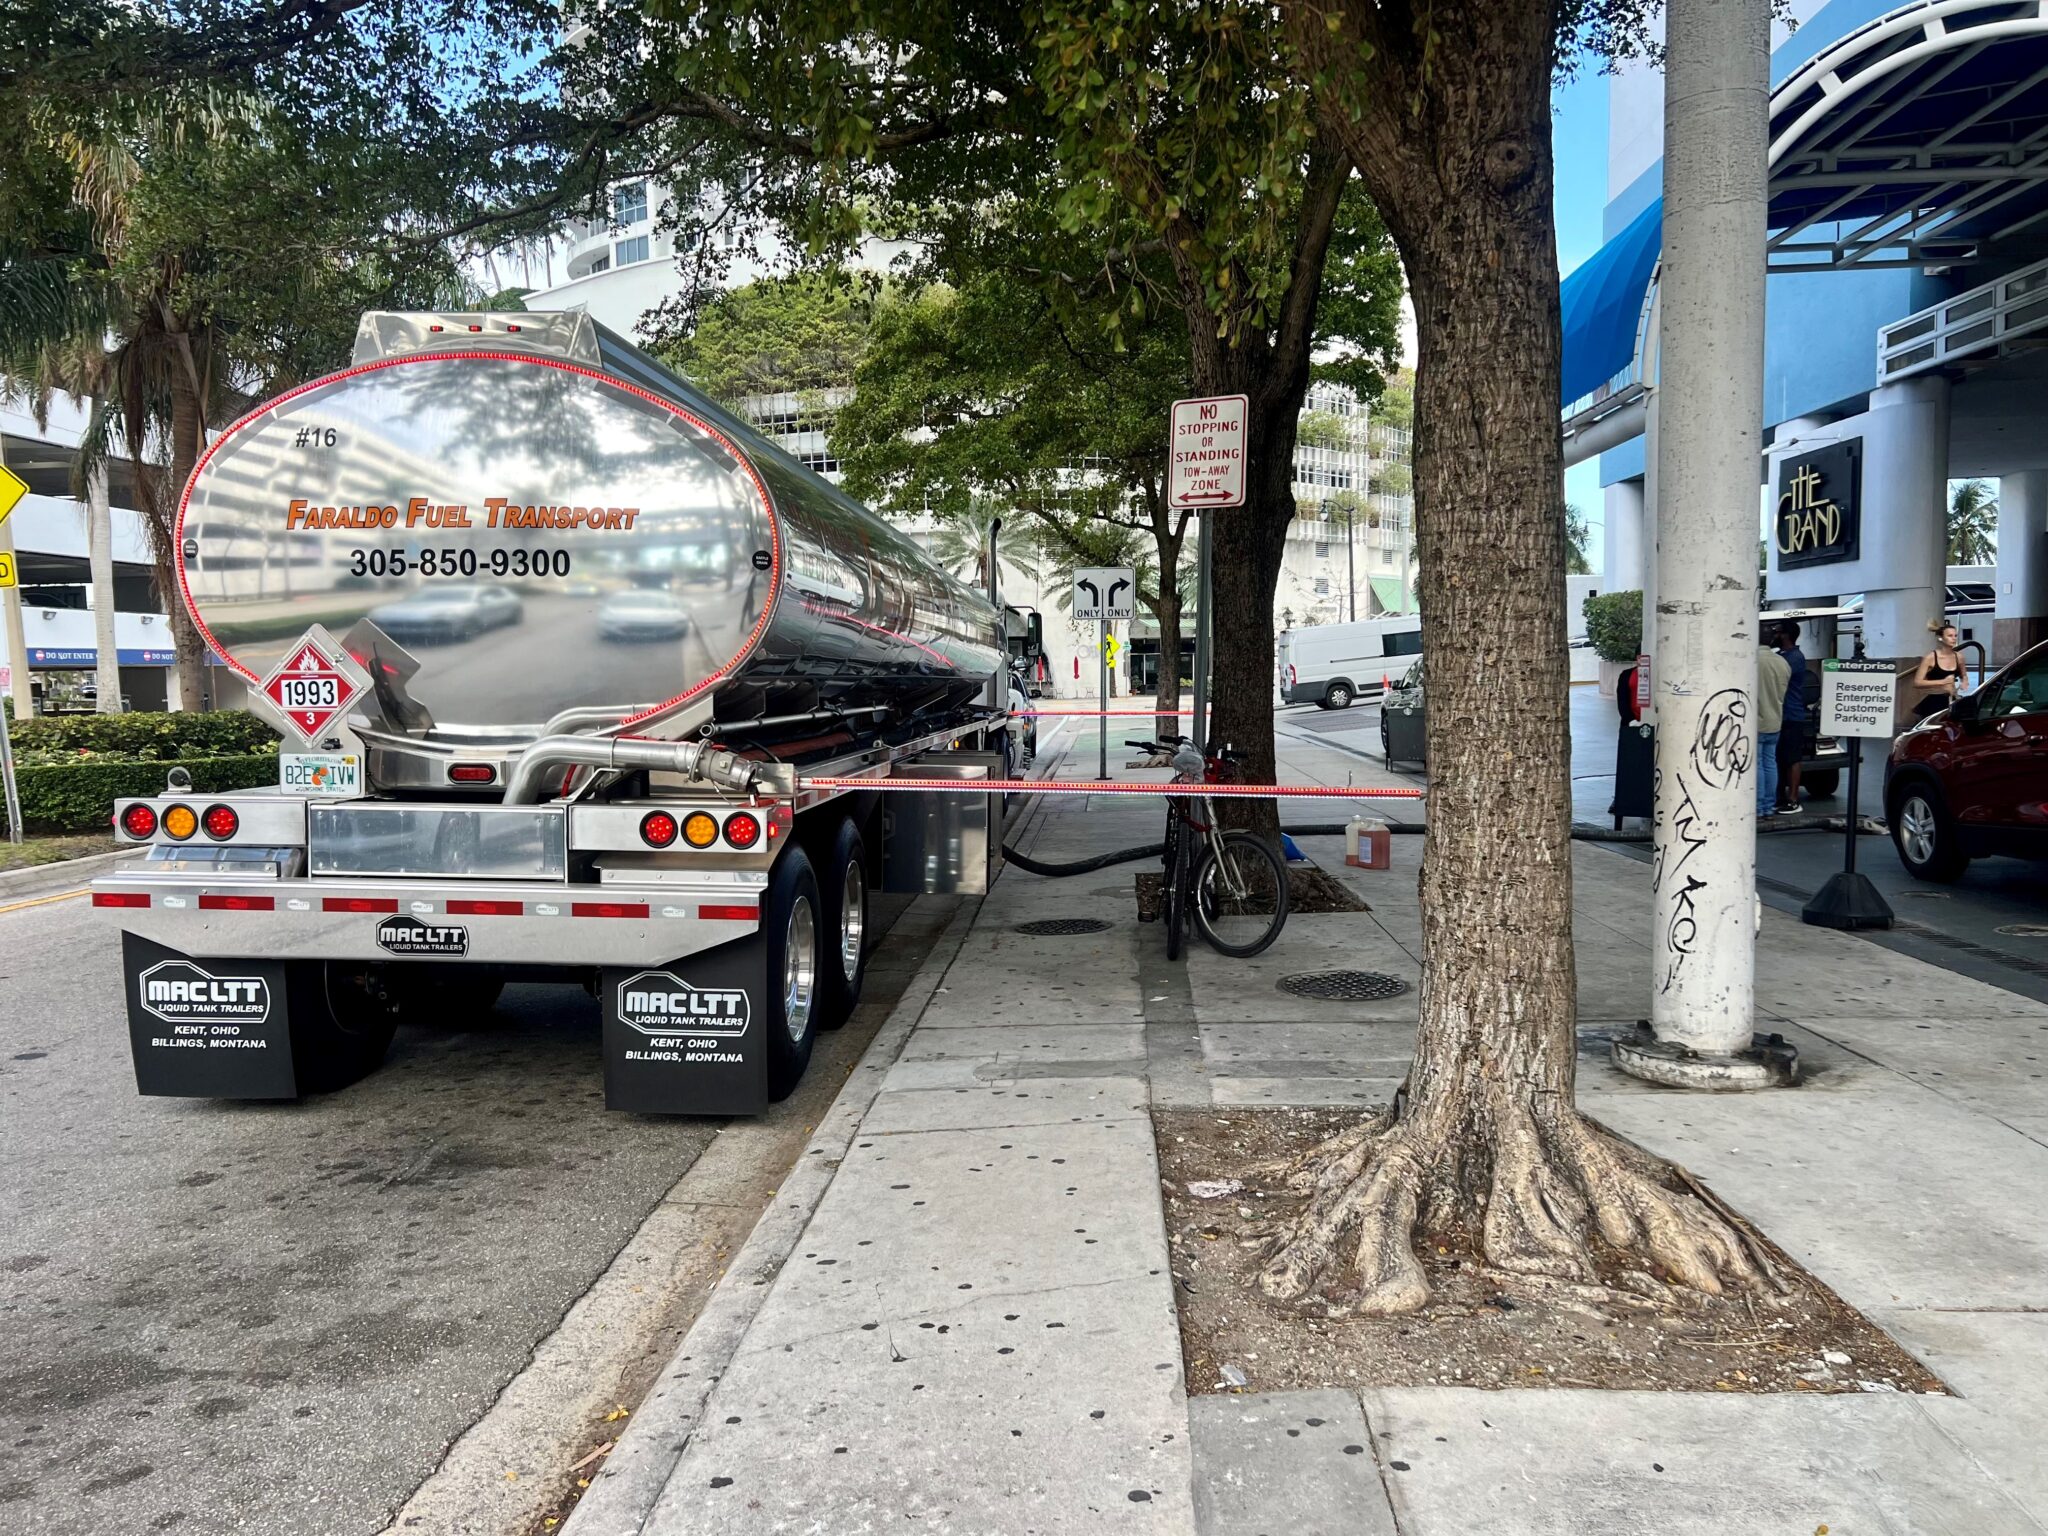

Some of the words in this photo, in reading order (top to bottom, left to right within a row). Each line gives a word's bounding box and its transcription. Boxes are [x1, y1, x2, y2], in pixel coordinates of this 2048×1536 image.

[1200, 404, 1217, 420] NO
[1179, 420, 1239, 435] STOPPING
[296, 427, 337, 448] #16
[1202, 436, 1213, 447] OR
[1176, 448, 1240, 462] STANDING
[1191, 479, 1221, 490] ZONE
[1789, 464, 1830, 511] THE
[286, 500, 398, 530] FARALDO
[405, 498, 473, 528] FUEL
[484, 498, 640, 530] TRANSPORT
[1775, 492, 1841, 555] GRAND
[350, 548, 571, 577] 305-850-9300
[1077, 609, 1100, 617] ONLY
[1107, 608, 1131, 617] ONLY
[1784, 610, 1806, 618] ICON
[58, 652, 72, 660] NOT
[73, 652, 94, 660] ENTER
[1825, 661, 1896, 672] enterprise
[1836, 682, 1888, 692] Reserved
[284, 680, 335, 706] 1993
[1835, 692, 1893, 704] Enterprise
[1835, 703, 1889, 713] Customer
[306, 712, 315, 725] 3
[1834, 713, 1877, 725] Parking
[158, 1004, 190, 1012] LIQUID
[192, 1004, 218, 1012] TANK
[220, 1004, 264, 1013] TRAILERS
[635, 1015, 668, 1024] LIQUID
[670, 1016, 696, 1025] TANK
[698, 1017, 744, 1026] TRAILERS
[174, 1025, 208, 1036] KENT,
[210, 1026, 240, 1035] OHIO
[152, 1038, 207, 1049] BILLINGS,
[209, 1039, 267, 1048] MONTANA
[650, 1038, 684, 1049] KENT,
[687, 1039, 718, 1048] OHIO
[625, 1050, 682, 1062] BILLINGS,
[685, 1052, 743, 1062] MONTANA
